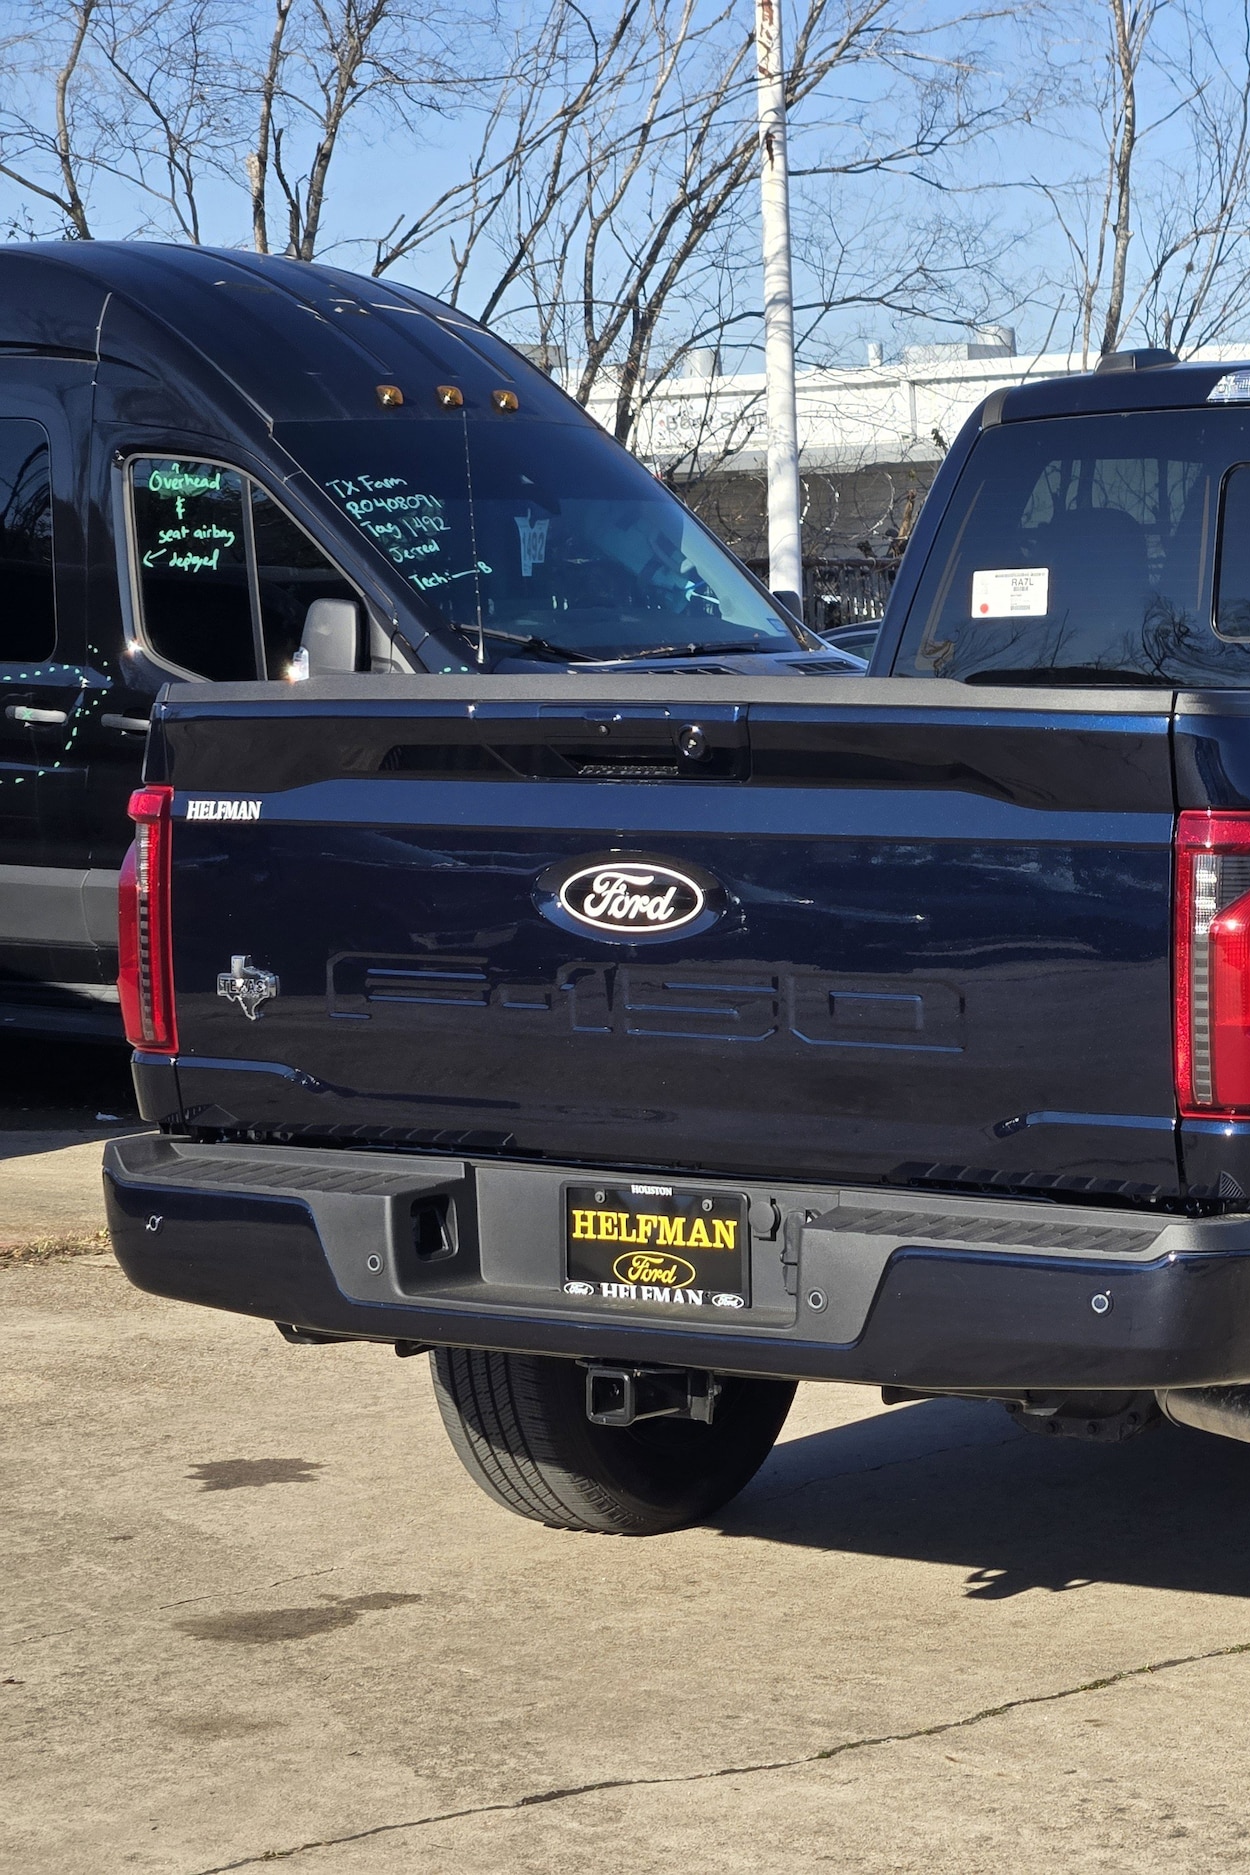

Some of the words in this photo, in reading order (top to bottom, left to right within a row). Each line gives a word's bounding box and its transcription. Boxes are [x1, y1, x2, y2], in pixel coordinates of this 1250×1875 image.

[149, 470, 221, 492] Overhead
[325, 479, 360, 499] TX
[158, 525, 190, 544] seat
[193, 523, 235, 547] airbag
[360, 520, 402, 539] Tag
[402, 515, 452, 538] 1492
[522, 531, 545, 561] 1492
[1011, 577, 1034, 586] RA7L
[186, 800, 263, 821] HELFMAN
[583, 871, 678, 921] Ford
[631, 1184, 673, 1197] HOUSTON
[571, 1209, 738, 1250] HELFMAN
[627, 1253, 678, 1285] Ford
